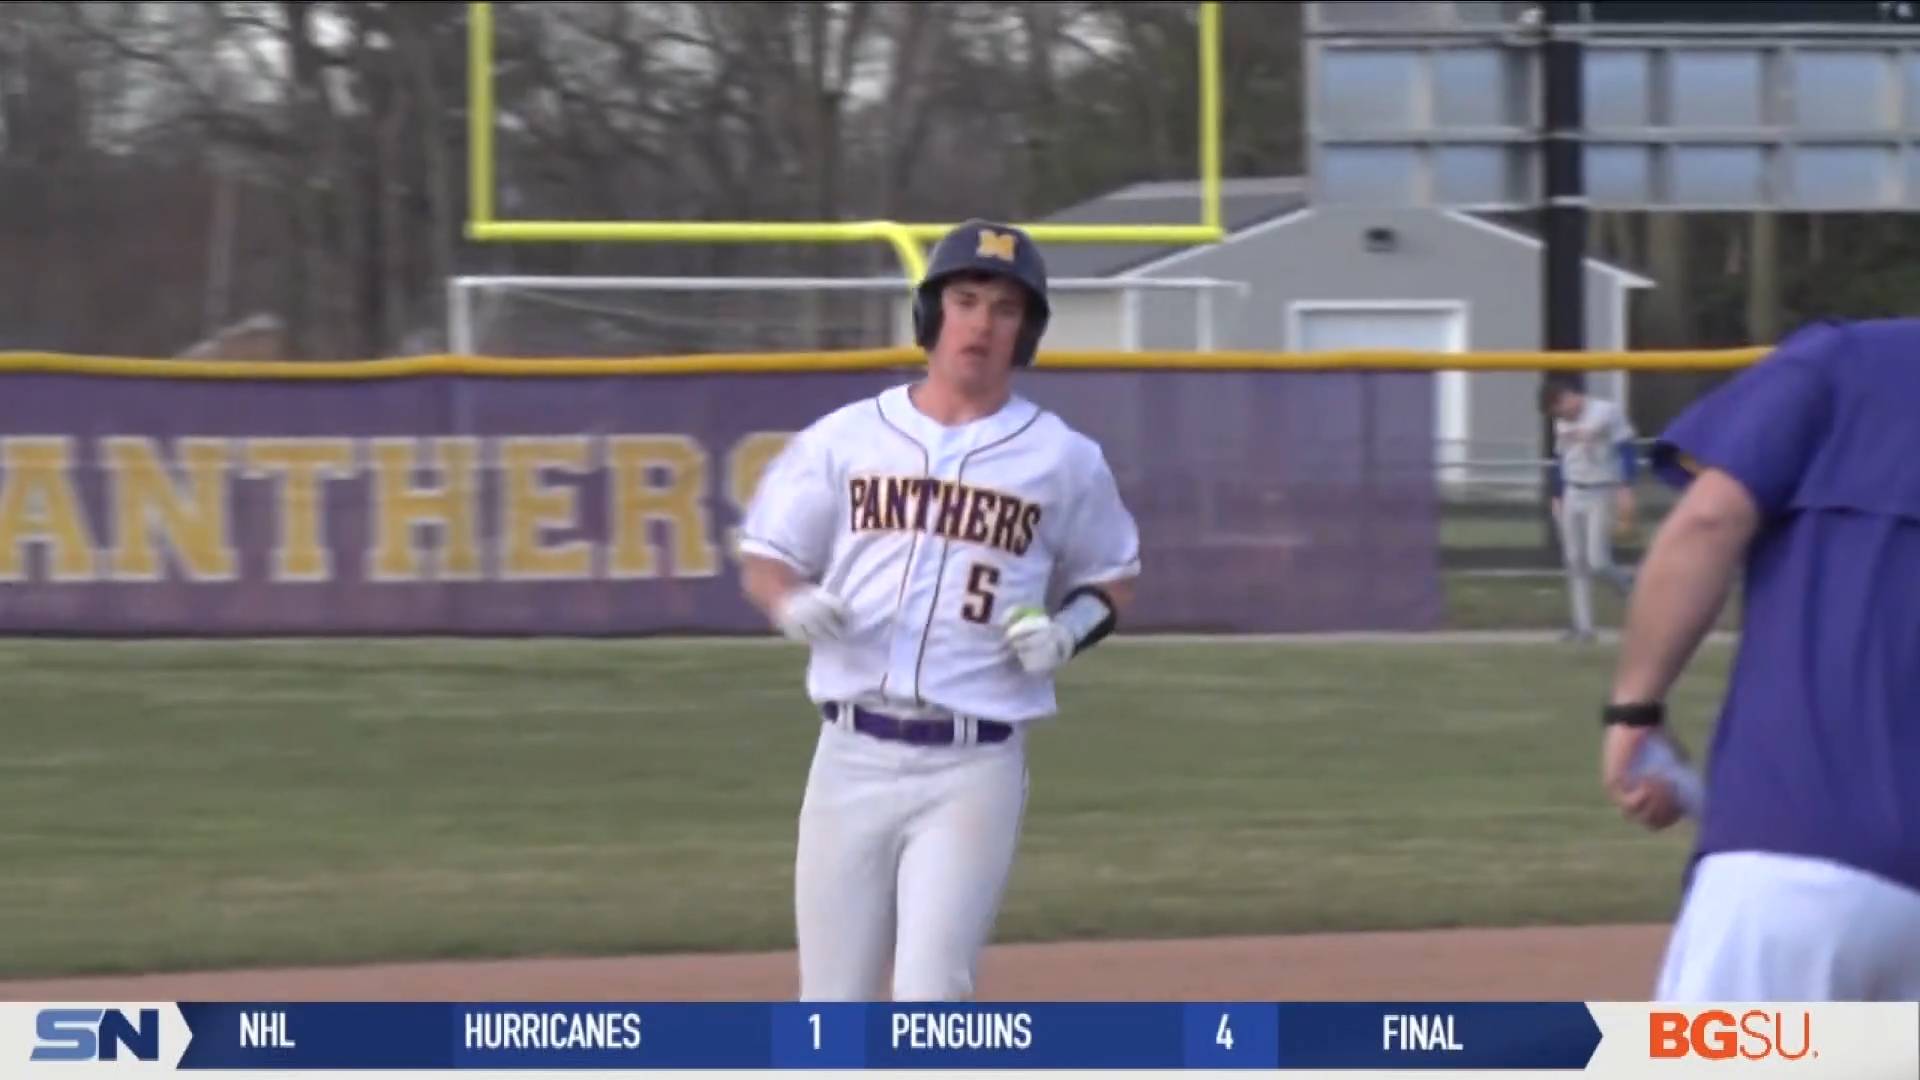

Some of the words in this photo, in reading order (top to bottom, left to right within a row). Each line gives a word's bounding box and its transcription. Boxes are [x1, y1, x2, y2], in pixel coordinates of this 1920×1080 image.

[975, 229, 1015, 262] M
[849, 476, 1042, 557] PANTHERS
[962, 563, 1000, 624] 5
